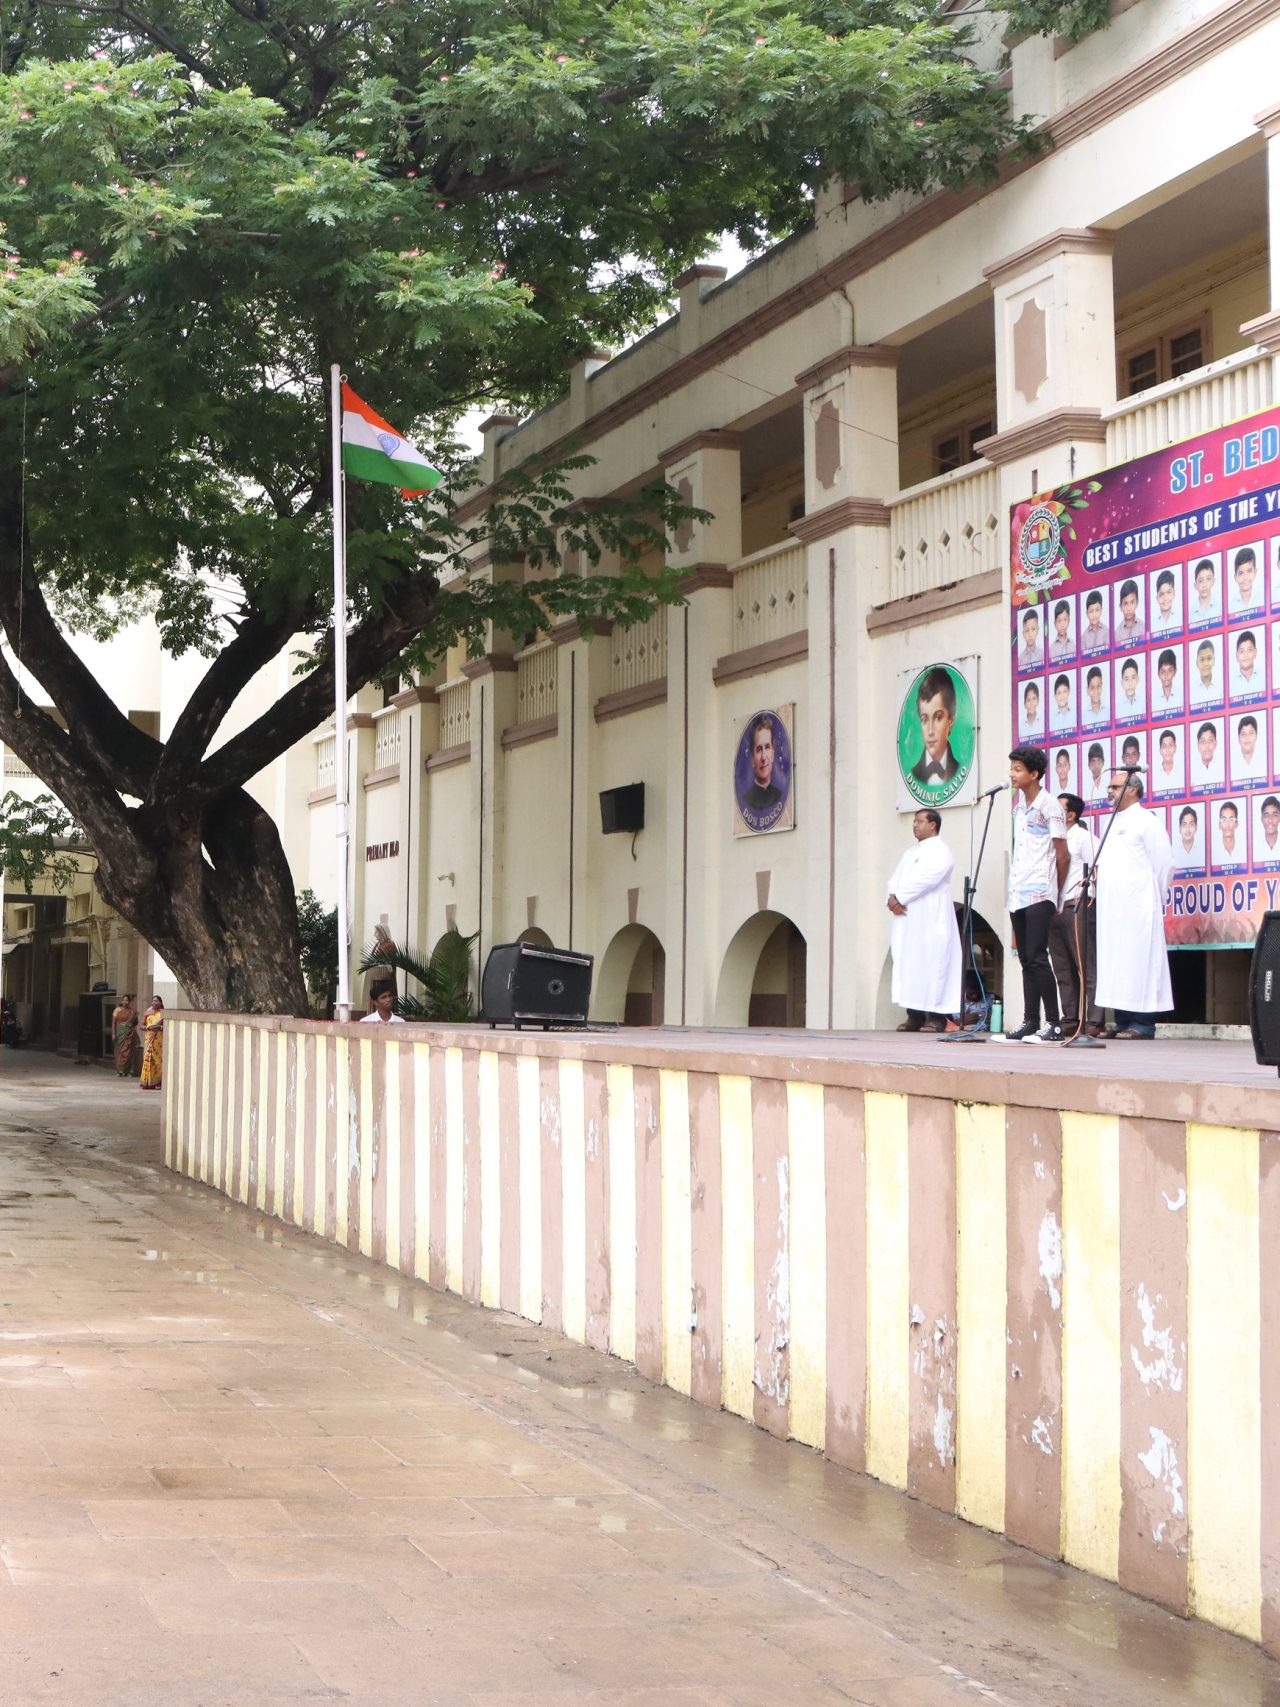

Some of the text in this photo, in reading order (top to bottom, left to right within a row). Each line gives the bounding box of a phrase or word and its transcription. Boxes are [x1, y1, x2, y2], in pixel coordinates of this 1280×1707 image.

[1170, 450, 1213, 494] ST.
[1086, 540, 1120, 567] BEST
[1124, 516, 1198, 555] STUDENTS
[1203, 507, 1222, 531] OF
[1228, 497, 1259, 523] THE
[906, 765, 968, 801] DOMINIC SAVIO
[742, 801, 783, 827] DON BOSCO
[1162, 878, 1280, 916] PROUD OF Y
